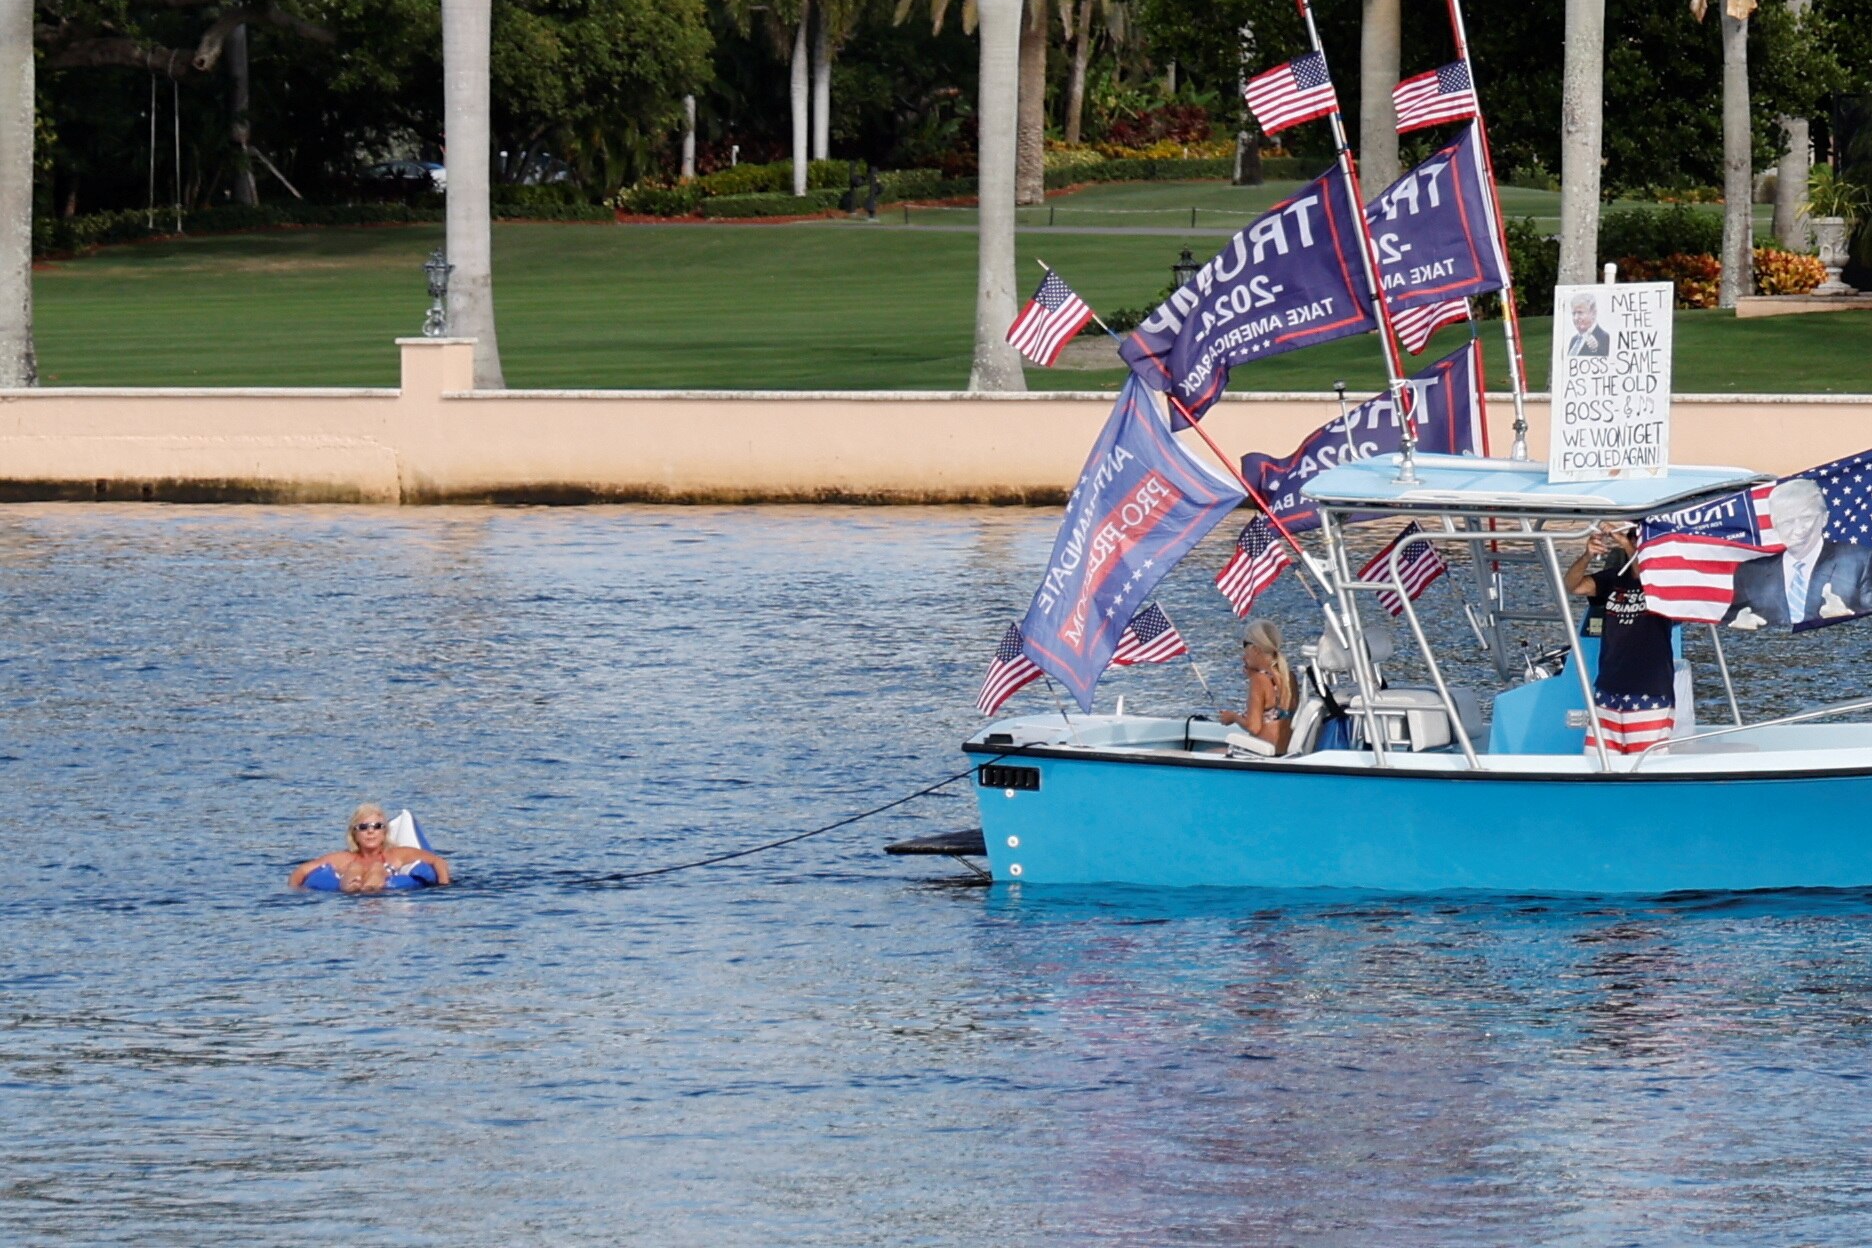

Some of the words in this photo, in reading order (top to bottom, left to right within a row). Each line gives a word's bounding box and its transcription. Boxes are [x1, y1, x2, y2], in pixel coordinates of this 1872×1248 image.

[1611, 289, 1667, 313] MEET
[1622, 312, 1653, 328] THE
[1617, 331, 1658, 350] NEW
[1616, 349, 1661, 375] SAME
[1564, 378, 1587, 399] AS
[1592, 375, 1619, 397] THE
[1622, 375, 1658, 394] OLD
[1563, 428, 1587, 448] WE
[1633, 421, 1664, 445] GET
[1563, 450, 1621, 470] FOOLED
